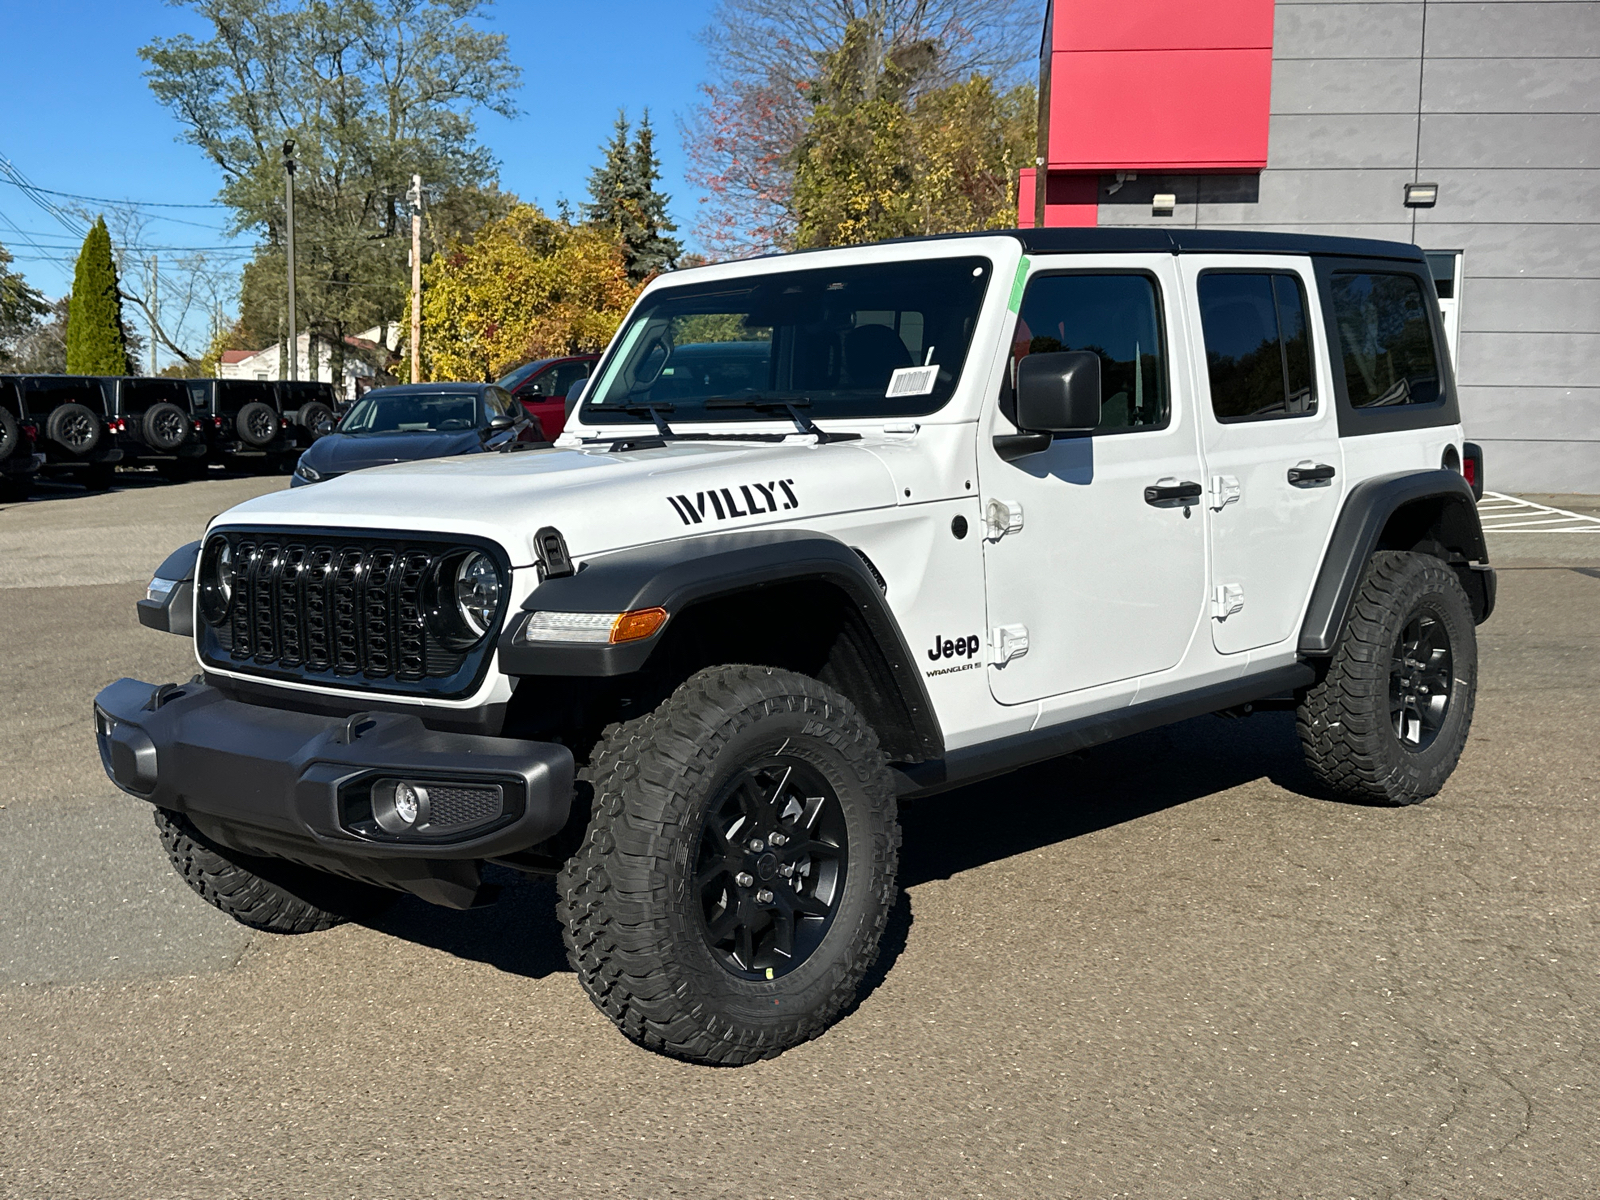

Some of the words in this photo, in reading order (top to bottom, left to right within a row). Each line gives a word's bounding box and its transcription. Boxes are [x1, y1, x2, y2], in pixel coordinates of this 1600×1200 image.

[666, 478, 799, 525] WILLYS
[928, 635, 979, 661] Jeep
[925, 663, 974, 678] WRANGLER
